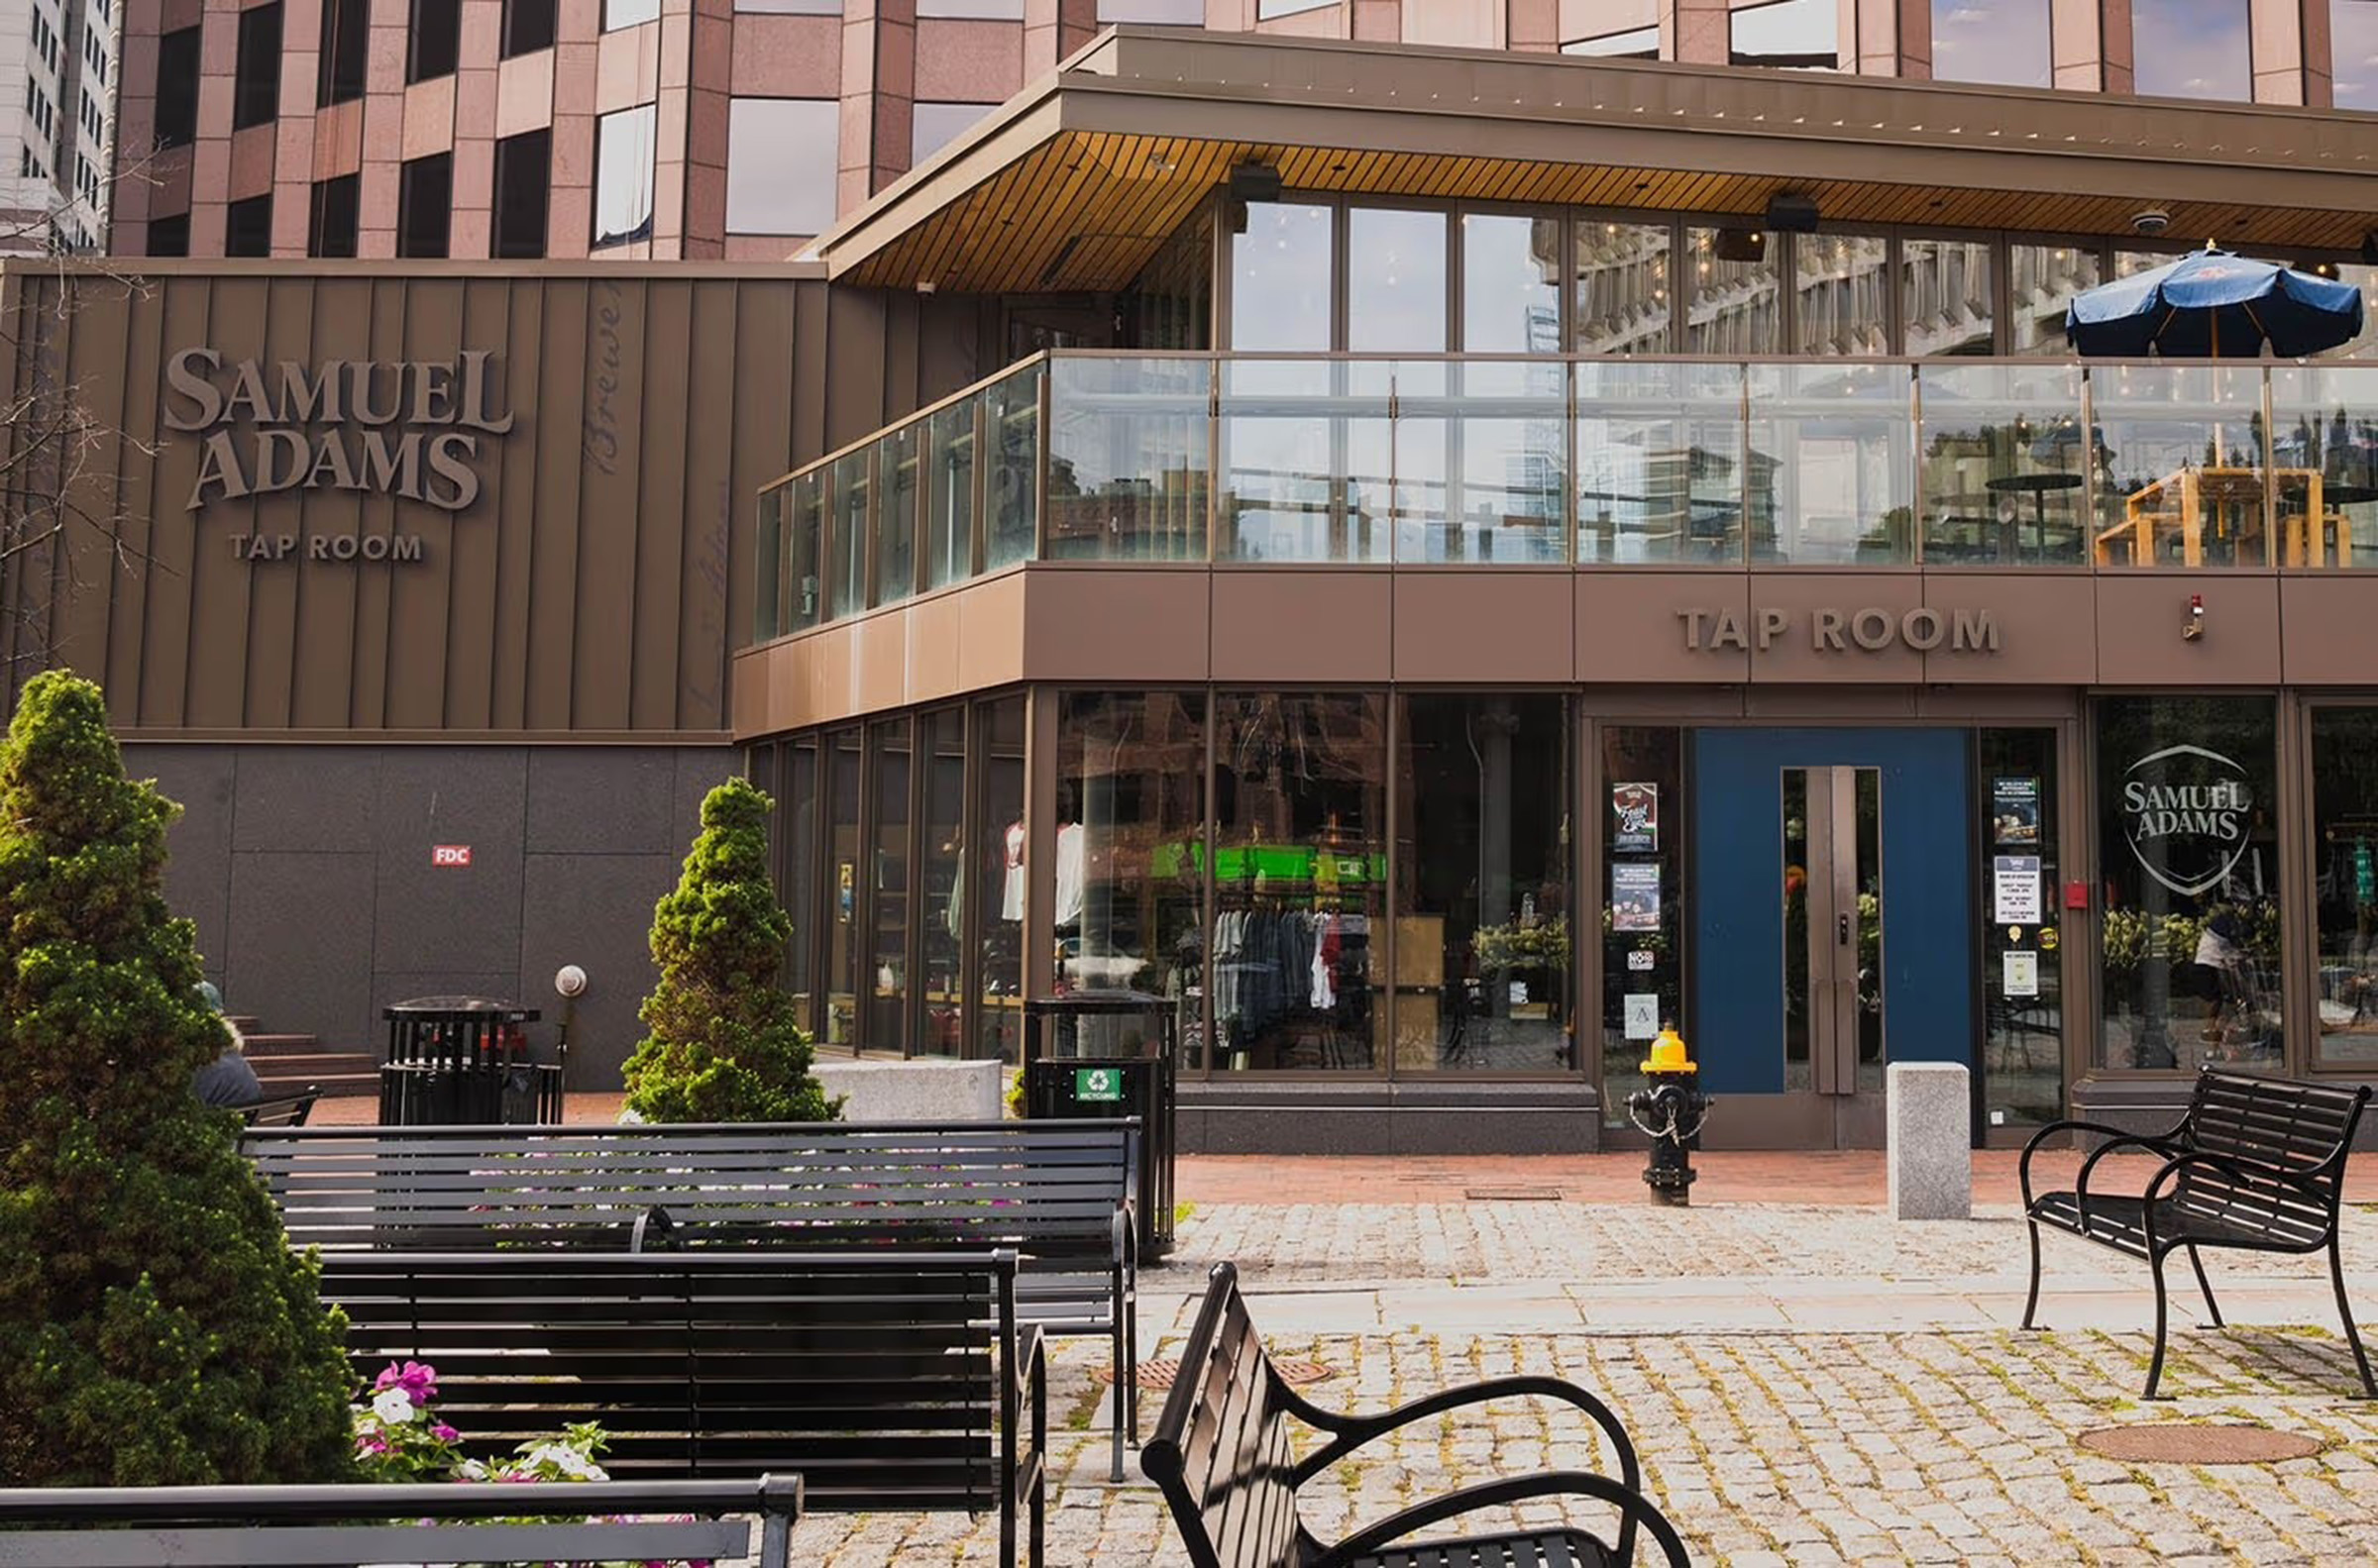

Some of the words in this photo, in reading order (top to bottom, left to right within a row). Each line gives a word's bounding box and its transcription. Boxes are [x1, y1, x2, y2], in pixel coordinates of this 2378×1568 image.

[163, 347, 514, 435] SAMUEL
[186, 430, 481, 512] ADAMS
[229, 533, 297, 562] TAP
[308, 534, 423, 562] ROOM
[1676, 606, 1789, 652] TAP
[1811, 606, 2001, 653] ROOM
[2123, 781, 2250, 813] SAMUEL
[2135, 810, 2239, 841] ADAMS
[436, 848, 468, 863] FDC
